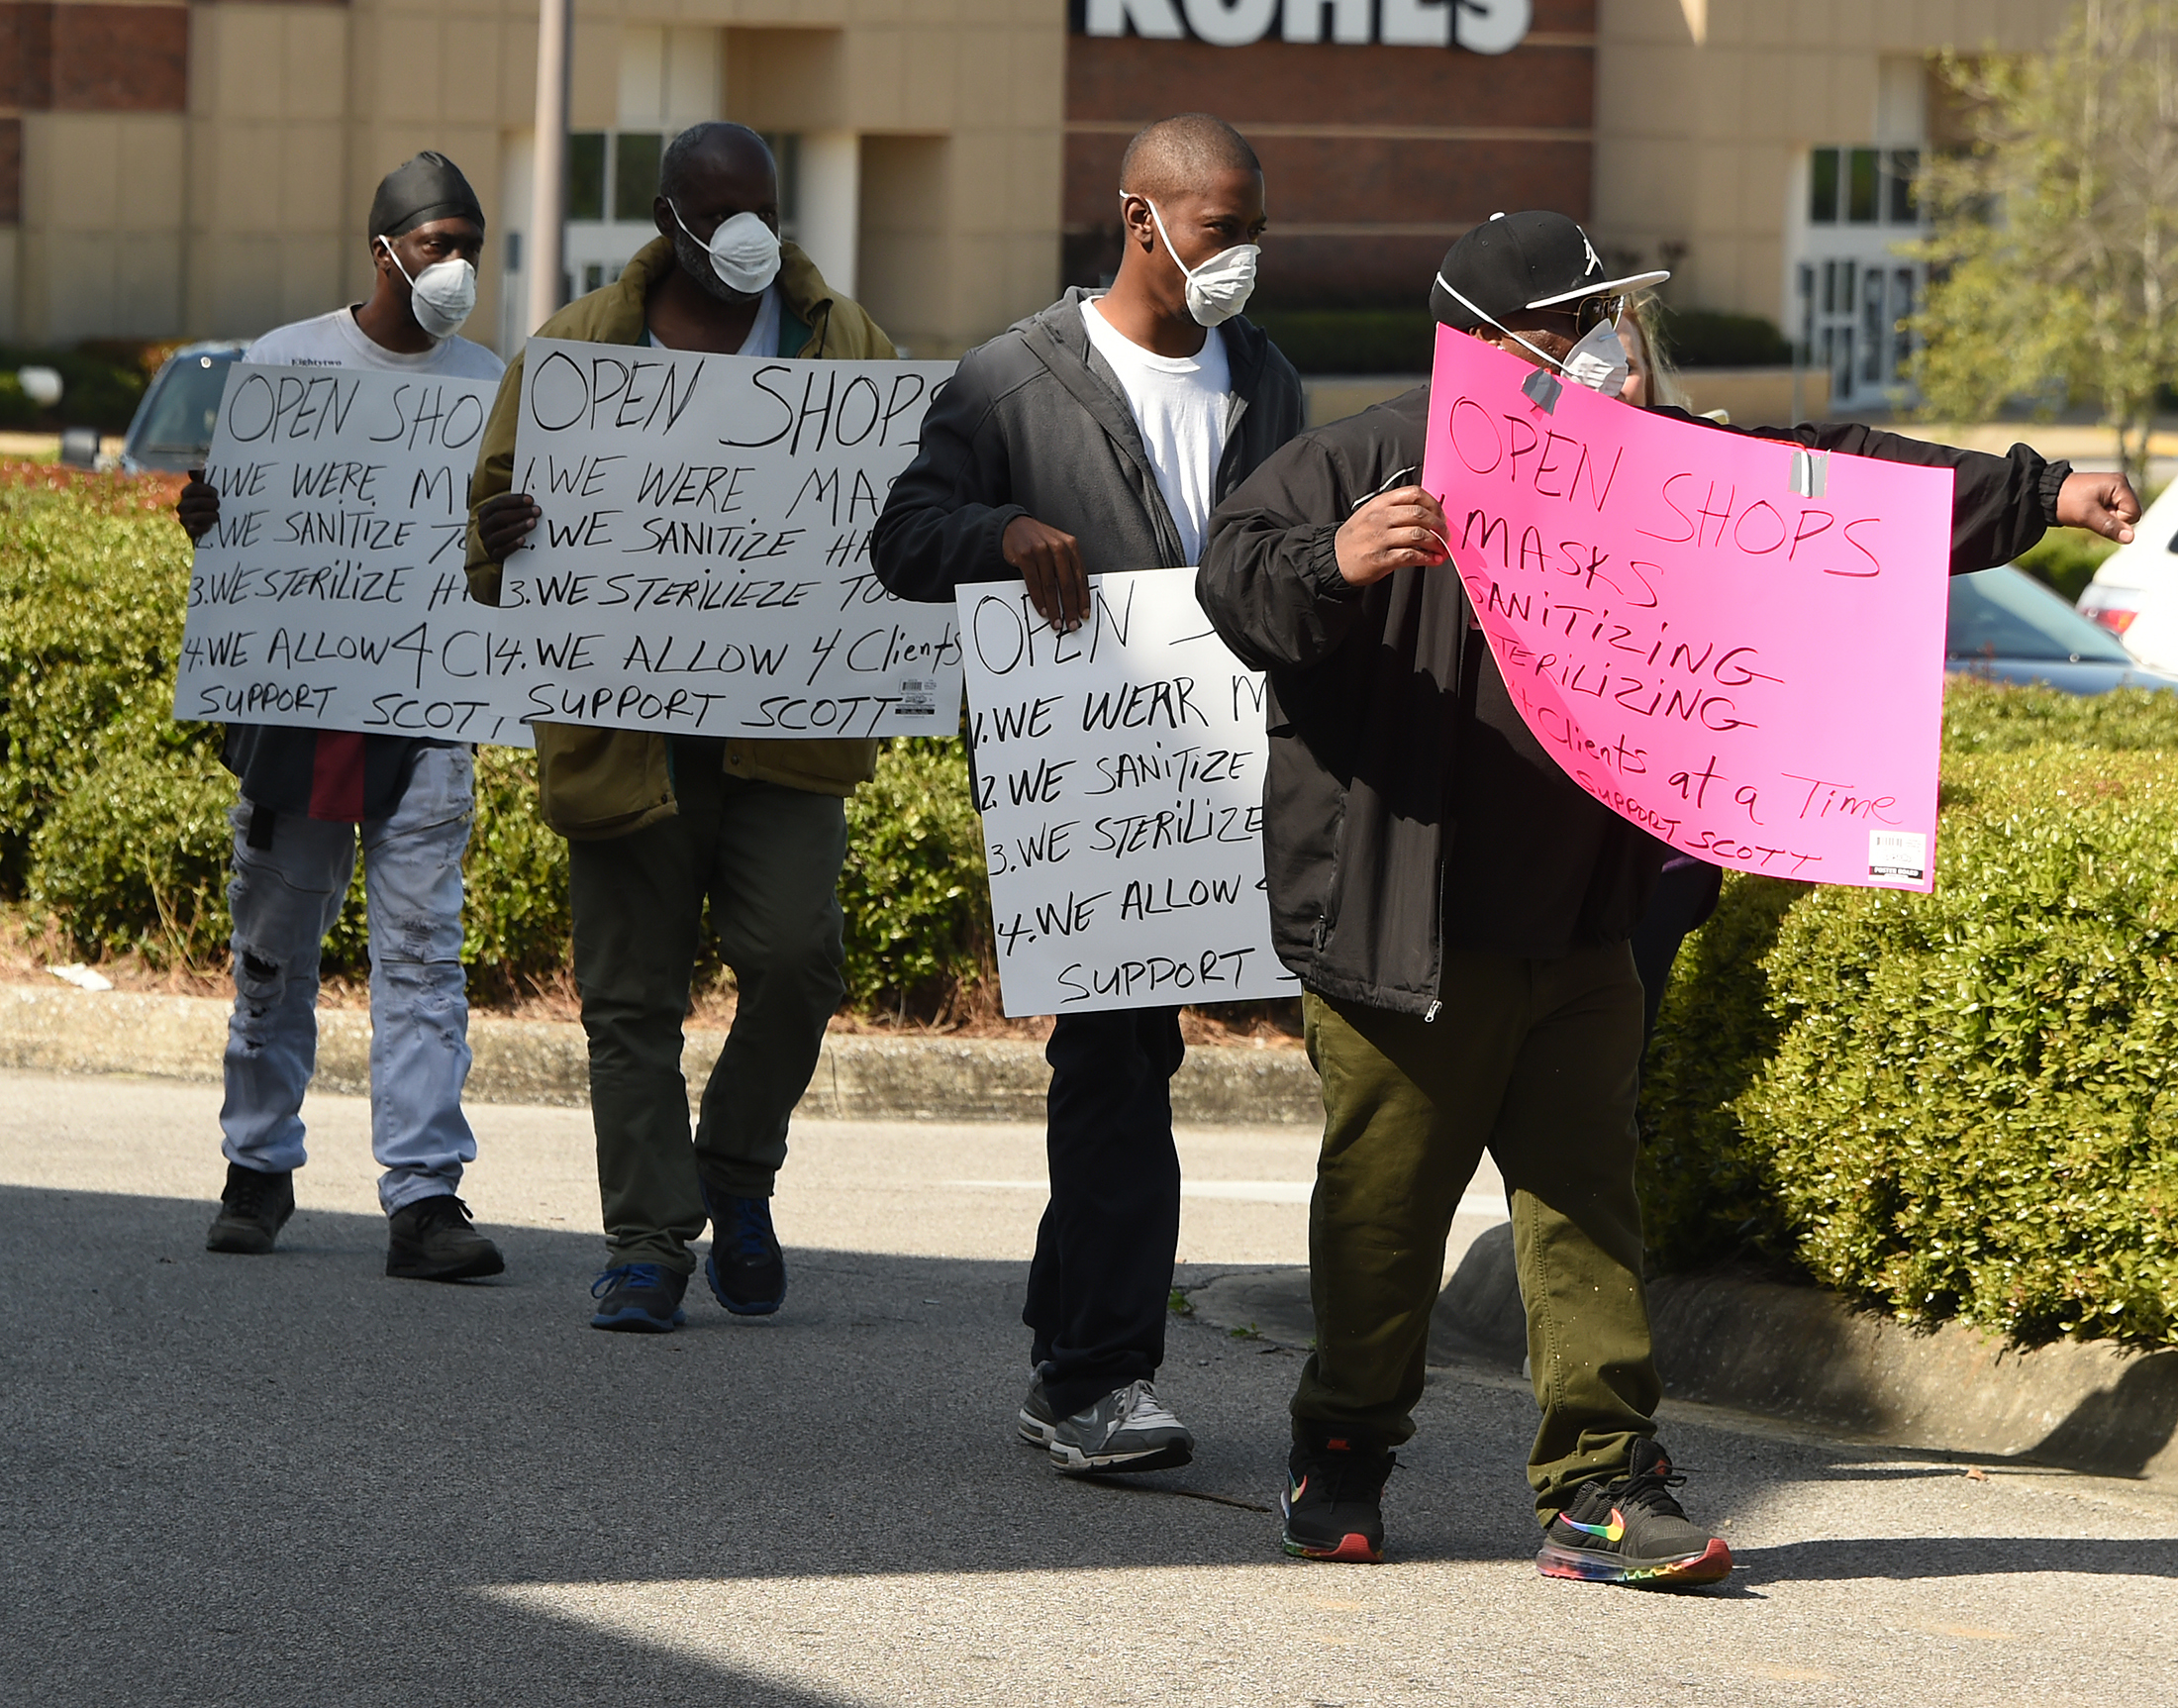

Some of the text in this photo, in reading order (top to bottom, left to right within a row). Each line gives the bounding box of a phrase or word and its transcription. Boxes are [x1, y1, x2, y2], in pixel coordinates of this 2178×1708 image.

[229, 373, 359, 444] OPEN
[531, 351, 705, 436] OPEN
[293, 462, 387, 500] WERE
[637, 461, 756, 515] WERE
[785, 467, 899, 527] MA
[1449, 396, 1881, 577] OPEN SHOPS
[1460, 509, 1665, 608] MASKS
[267, 628, 391, 670] ALLOW
[623, 635, 788, 675] ALLOW
[807, 628, 842, 686] 4
[846, 623, 962, 674] Clients
[973, 579, 1135, 675] OPEN
[198, 683, 338, 719] SUPPORT
[519, 683, 728, 728] SUPPORT
[741, 696, 904, 738] SCOTT
[1082, 676, 1210, 732] WEAR
[1537, 707, 1648, 775] Clients
[1667, 754, 1730, 810] at
[1734, 785, 1765, 826] a
[1781, 772, 1904, 826] Time
[1684, 831, 1823, 875] SCOTT
[1120, 874, 1241, 921] ALLOW
[1057, 947, 1256, 1004] SUPPORT
